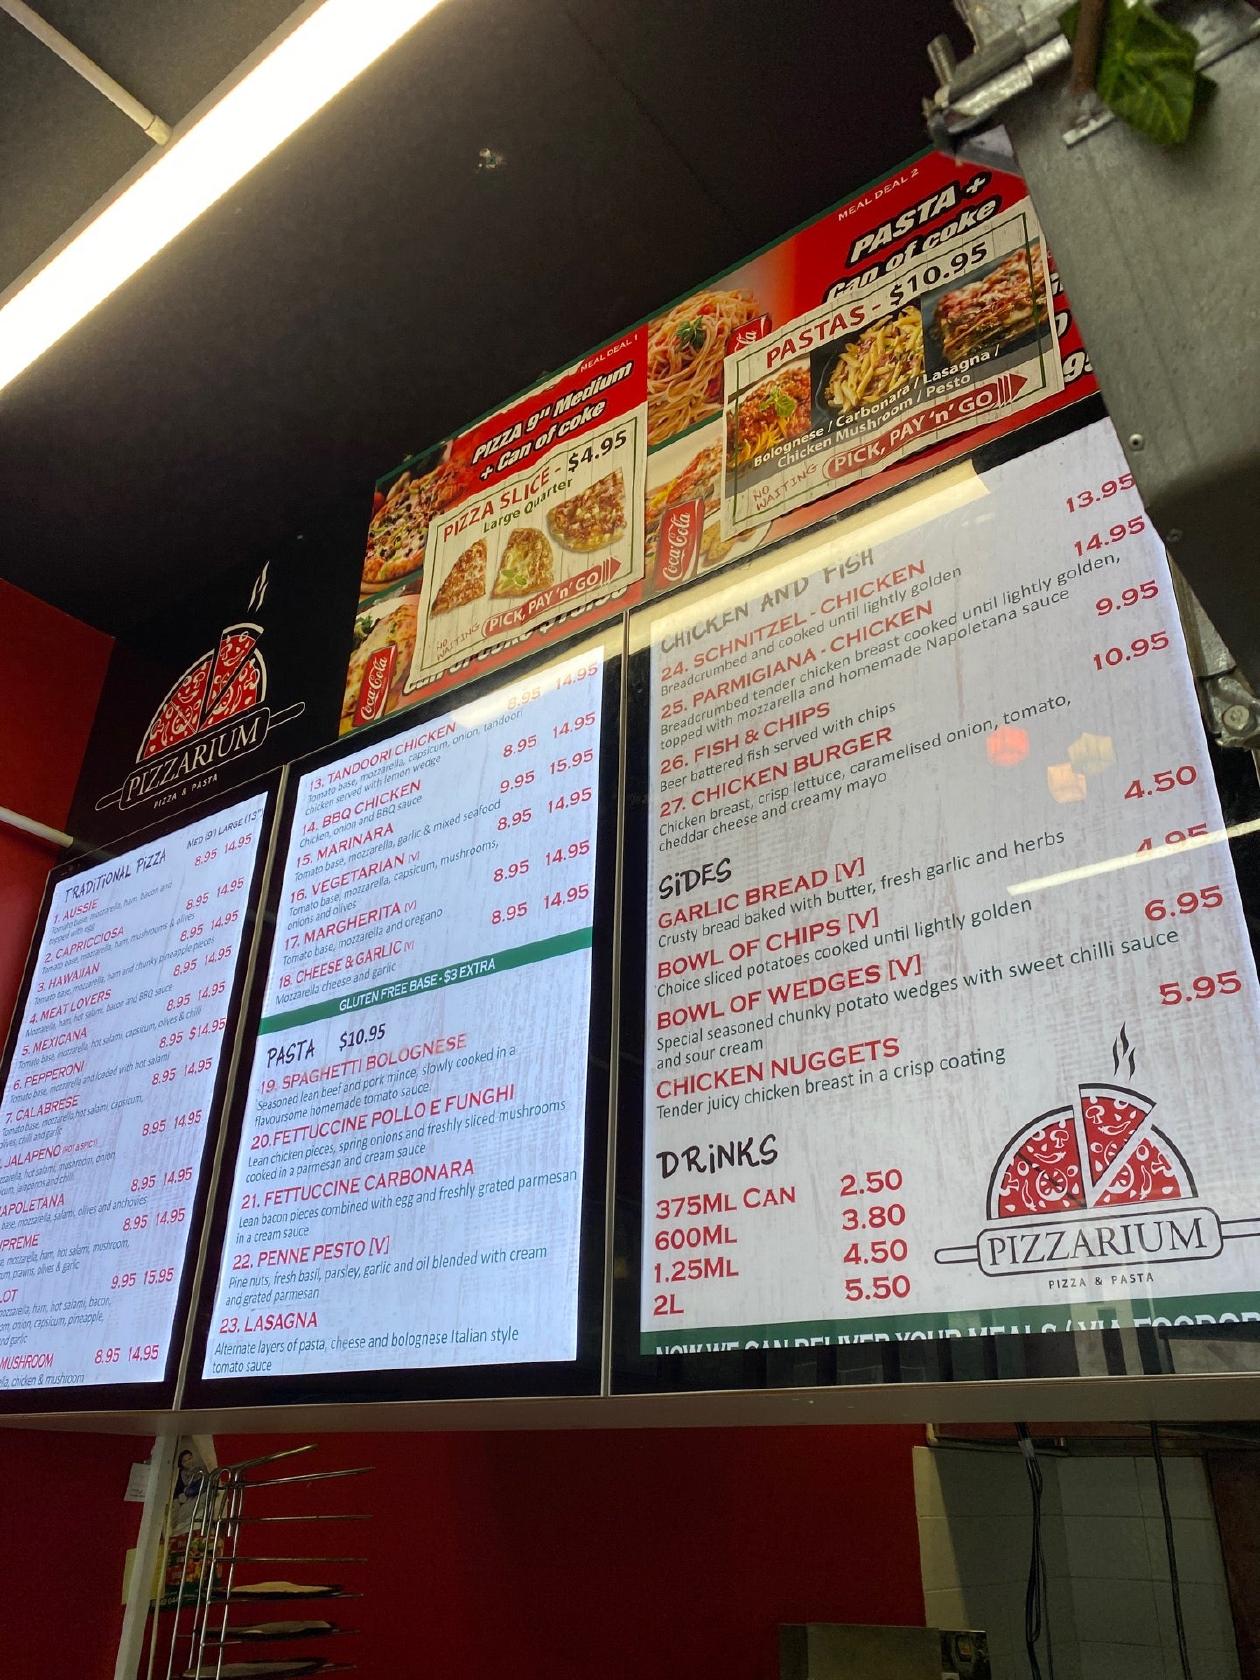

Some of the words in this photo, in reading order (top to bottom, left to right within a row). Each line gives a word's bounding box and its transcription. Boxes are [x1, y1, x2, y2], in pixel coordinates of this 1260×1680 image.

[838, 194, 872, 222] MEAL
[874, 172, 908, 200] DEAL
[910, 166, 919, 177] 2
[848, 184, 958, 264] PASTA
[826, 262, 879, 305] Can
[883, 238, 921, 274] of
[920, 196, 998, 253] coke
[766, 298, 865, 373] PASTAS
[888, 236, 989, 309] $10.95
[606, 337, 632, 357] DEAL
[472, 422, 522, 464] PIZZA
[552, 359, 632, 417] Medium
[753, 423, 824, 473] Bolognese
[835, 381, 911, 433] Carbonara
[922, 343, 991, 391] Lasagna
[777, 432, 834, 471] Chicken
[835, 394, 913, 446] Mushroom
[925, 367, 971, 402] Pesto
[833, 436, 886, 477] PICK,
[888, 416, 924, 448] PAY
[961, 386, 994, 415] GO
[496, 439, 530, 471] Can
[534, 425, 555, 450] of
[556, 396, 605, 437] coke
[442, 498, 494, 543] PIZZA
[499, 466, 550, 513] SLICE
[567, 426, 627, 475] $4.95
[483, 505, 520, 536] Large
[524, 475, 572, 515] Quarter
[753, 484, 770, 502] NO
[756, 461, 819, 510] WAITING
[1066, 469, 1140, 513] 13.95
[1074, 515, 1145, 557] 14.95
[489, 604, 525, 634] PICK,
[528, 590, 552, 614] PAY
[576, 568, 599, 591] GO
[760, 576, 810, 612] AND
[1095, 579, 1159, 617] 9.95
[661, 661, 689, 682] 24.
[693, 612, 808, 669] SCHNITZEL
[820, 559, 925, 614] CHICKEN
[660, 699, 688, 720] 25.
[693, 647, 817, 708] PARMIGIANA
[829, 600, 932, 653] CHICKEN
[1093, 630, 1169, 671] 10.95
[503, 734, 537, 758] 8.95
[553, 711, 596, 739] 14.95
[660, 754, 689, 775] 26.
[694, 734, 739, 763] FISH
[744, 729, 759, 745] &
[763, 702, 830, 737] CHIPS
[126, 718, 260, 802] PIZZARIUM
[191, 774, 218, 791] PASTA
[659, 796, 686, 818] 27.
[691, 761, 788, 807] CHICKEN
[794, 727, 892, 774] BURGER
[1124, 765, 1197, 800] 4.50
[303, 821, 318, 835] 14.
[322, 807, 352, 829] BBQ
[354, 779, 421, 815] CHICKEN
[658, 929, 698, 948] Crusty
[702, 914, 740, 937] bread
[744, 902, 786, 925] baked
[790, 893, 822, 914] with
[826, 882, 876, 904] butter,
[879, 867, 921, 890] fresh
[926, 856, 971, 881] garlic
[975, 842, 1008, 865] and
[1013, 831, 1065, 855] herbs
[658, 893, 739, 929] GARLIC
[745, 869, 828, 907] BREAD
[835, 856, 865, 883] [V]
[1144, 885, 1224, 921] 6.95
[204, 944, 232, 966] 14.95
[657, 949, 724, 979] BOWL
[728, 938, 761, 961] OF
[765, 919, 841, 952] CHIPS
[847, 906, 879, 934] [V]
[172, 958, 198, 977] 8.95
[339, 989, 380, 1012] GLUTEN
[380, 982, 409, 1000] FREE
[409, 973, 439, 992] BASE
[443, 968, 458, 984] $3
[458, 957, 496, 978] EXTRA
[657, 1000, 725, 1031] BOWL
[729, 990, 762, 1013] OF
[767, 964, 881, 1005] WEDGES
[887, 953, 922, 981] [V]
[1159, 970, 1242, 1006] 5.95
[29, 1013, 38, 1025] 4.
[39, 1002, 70, 1022] MEAT
[70, 988, 112, 1013] LOVERS
[267, 1038, 316, 1069] PASTA
[339, 1023, 386, 1052] $10.95
[656, 1062, 764, 1099] CHICKEN
[771, 1037, 900, 1079] NUGGETS
[250, 1114, 369, 1151] 20.FETTUCCINE
[371, 1102, 426, 1128] POLLO
[430, 1098, 442, 1116] E
[444, 1084, 514, 1113] FUNGHI
[241, 1193, 260, 1210] 21.
[263, 1177, 361, 1207] FETTUCCINE
[364, 1158, 474, 1192] CARBONARA
[840, 1168, 903, 1197] 2.50
[842, 1203, 906, 1231] 3.80
[987, 1217, 1207, 1266] PIZZARIUM
[232, 1253, 254, 1271] 22.
[257, 1246, 311, 1268] PENNE
[312, 1239, 366, 1262] PESTO
[368, 1235, 390, 1257] [V]
[843, 1238, 908, 1265] 4.50
[653, 1293, 684, 1316] 2L
[845, 1274, 911, 1302] 5.50
[1048, 1277, 1087, 1290] PIZZA
[1094, 1276, 1103, 1286] &
[1111, 1272, 1154, 1285] PASTA
[219, 1317, 240, 1334] 23.
[244, 1311, 318, 1333] LASAGNA
